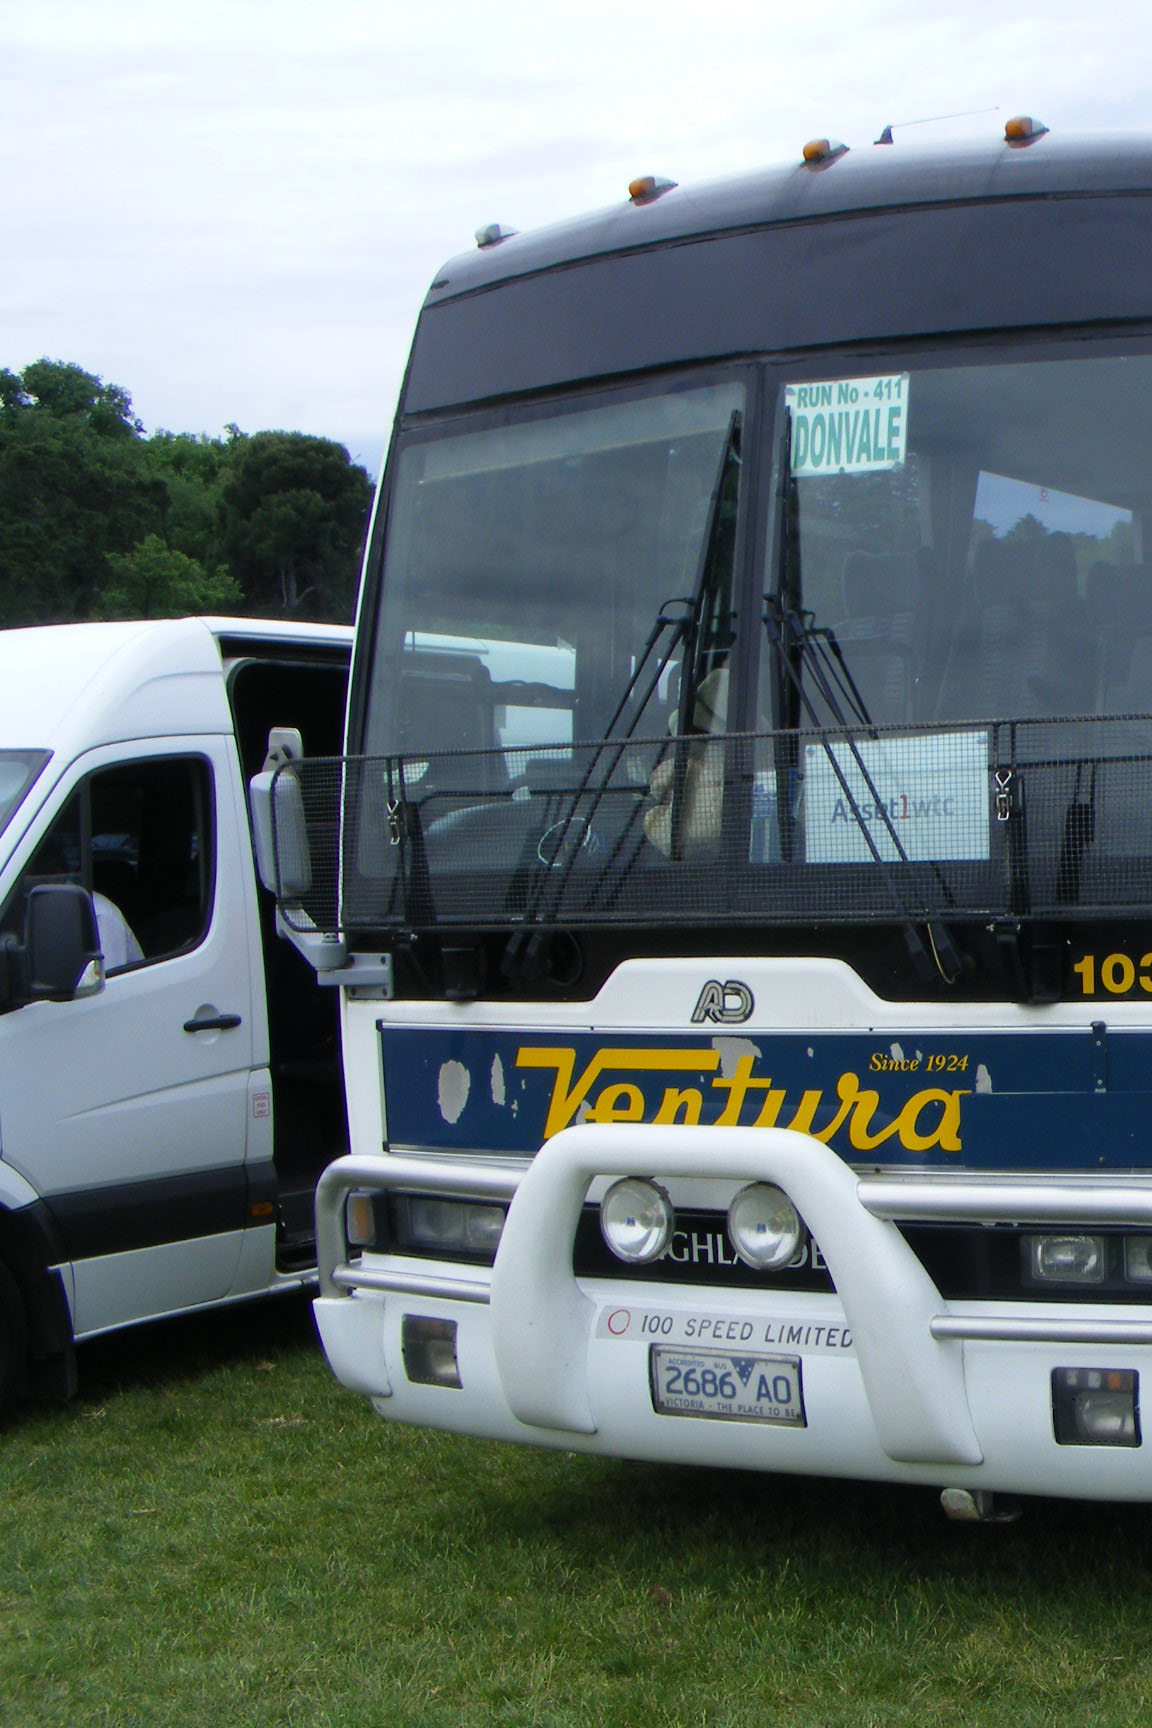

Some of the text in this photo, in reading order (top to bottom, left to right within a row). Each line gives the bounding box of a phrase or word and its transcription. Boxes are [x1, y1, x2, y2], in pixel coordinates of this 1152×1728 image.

[797, 386, 832, 408] RUN
[837, 383, 859, 404] No
[873, 379, 901, 400] 411
[794, 406, 901, 468] DONVALE
[869, 1052, 969, 1072] Since 1924
[515, 1047, 972, 1152] Ventura
[641, 1314, 853, 1348] 100 SPEED LIMITED
[665, 1366, 737, 1399] 2686
[665, 1398, 704, 1410] VICTORIA
[717, 1402, 732, 1412] THE
[738, 1404, 764, 1415] PLACE
[768, 1408, 780, 1416] TO
[785, 1409, 797, 1418] BE
